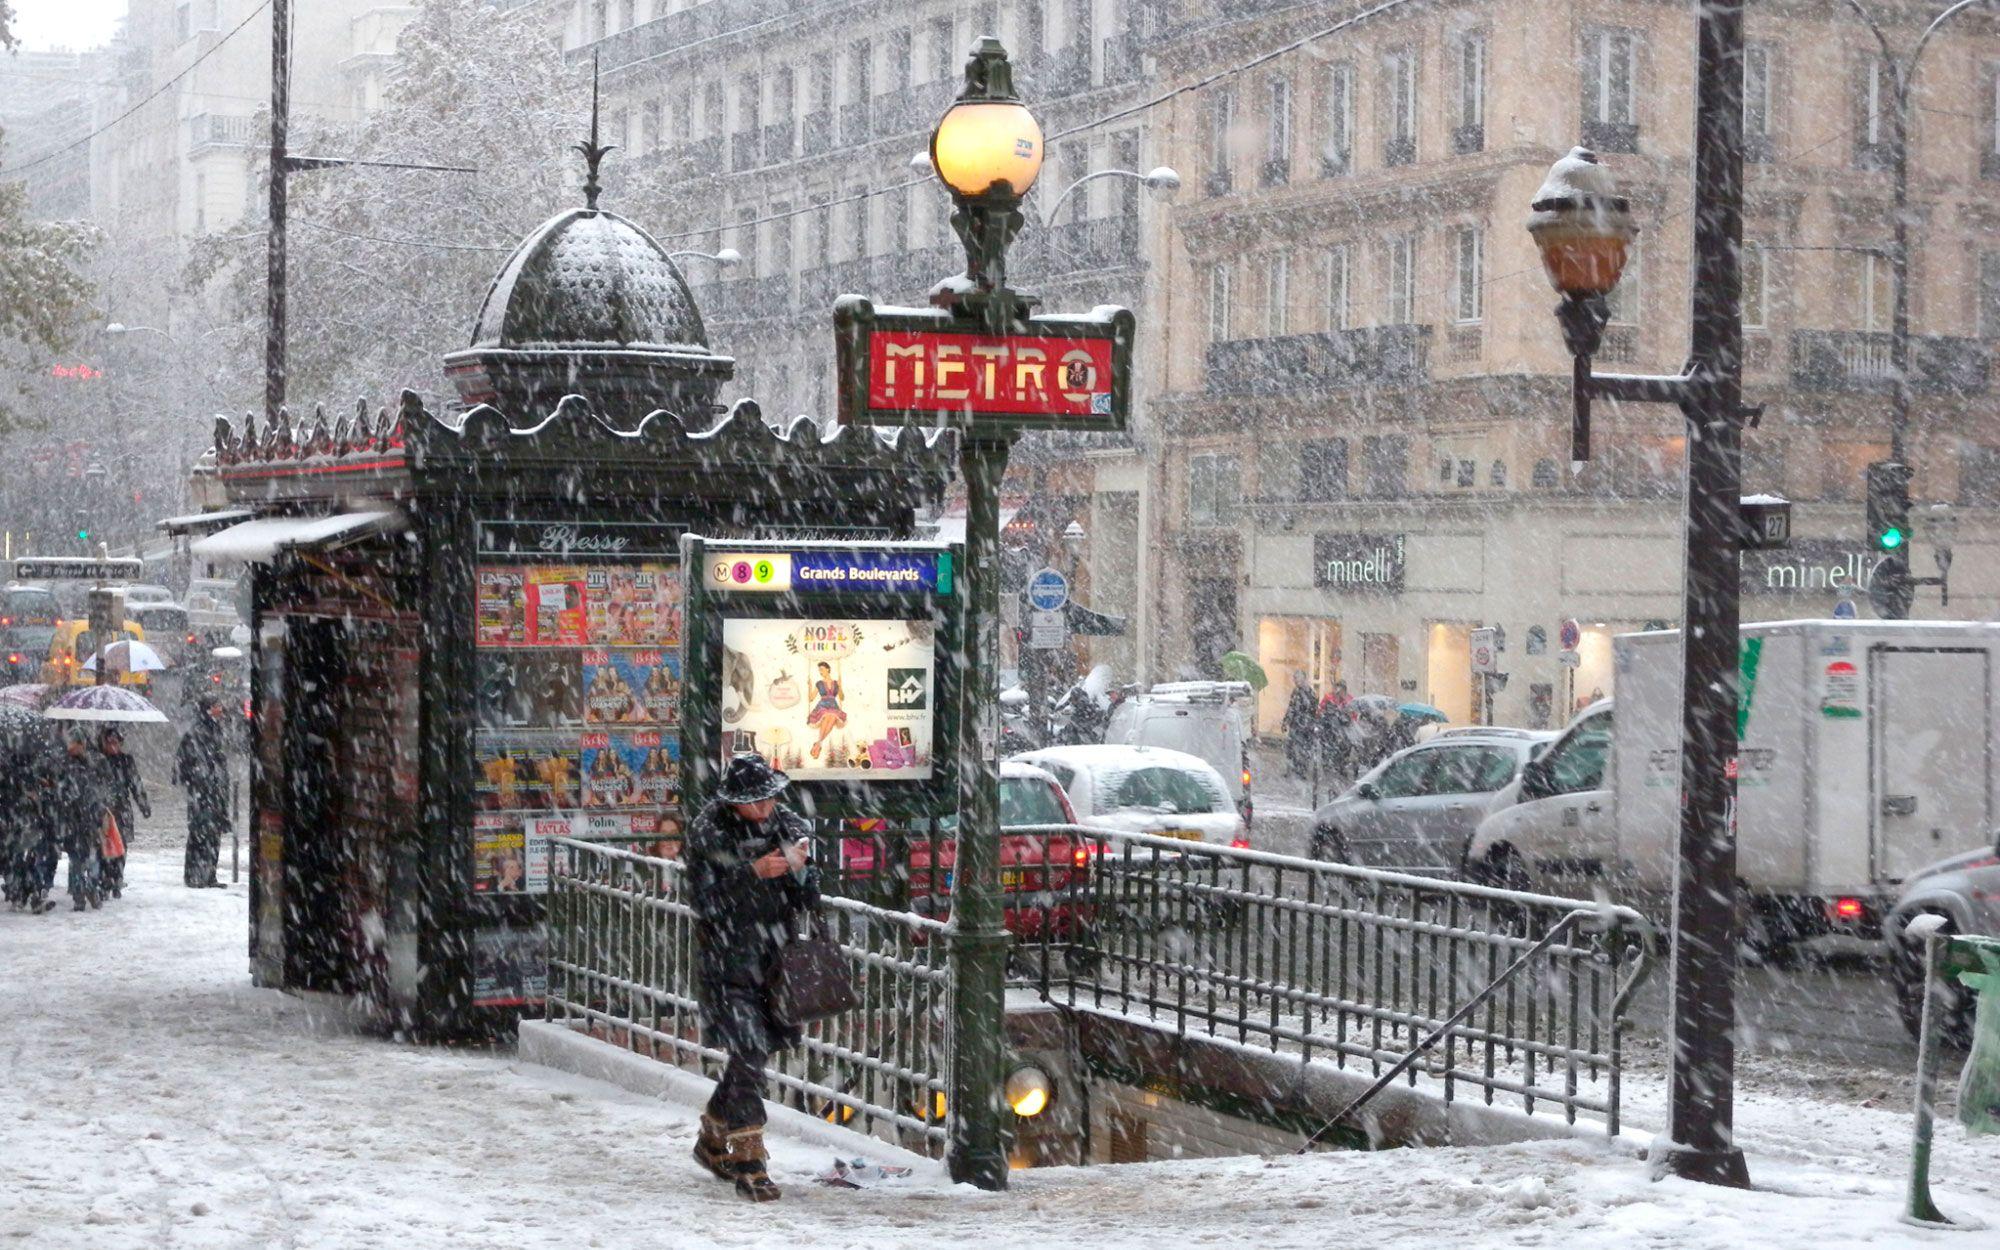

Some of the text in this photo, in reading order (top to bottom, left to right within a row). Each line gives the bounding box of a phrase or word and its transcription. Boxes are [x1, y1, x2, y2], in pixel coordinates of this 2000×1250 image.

[884, 343, 1097, 402] METRO
[538, 526, 629, 551] Presse
[1769, 517, 1783, 537] 27
[716, 564, 919, 581] M 8 9 Grands Boulevards
[1327, 547, 1390, 582] minelli
[1767, 554, 1872, 588] minelli
[804, 625, 847, 641] NOËL
[804, 642, 847, 651] CIRCUS
[889, 676, 923, 704] BHV
